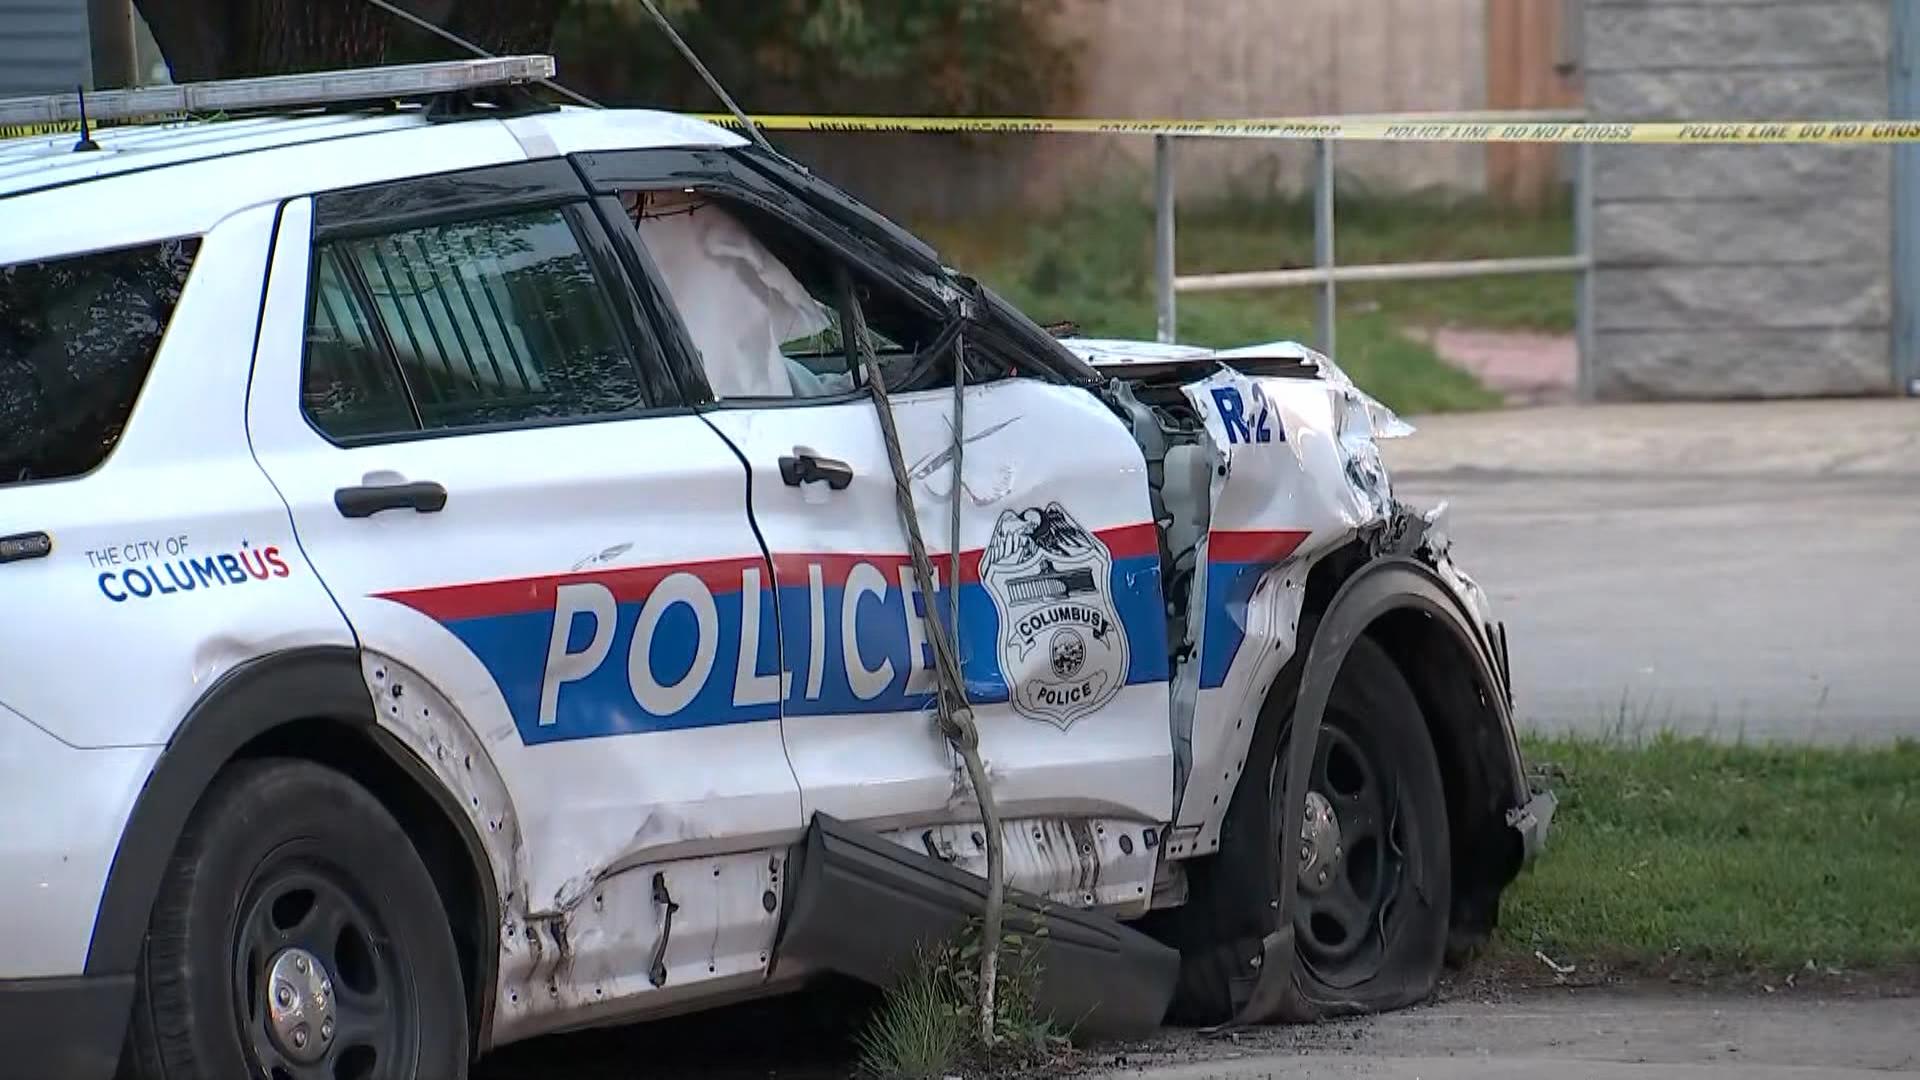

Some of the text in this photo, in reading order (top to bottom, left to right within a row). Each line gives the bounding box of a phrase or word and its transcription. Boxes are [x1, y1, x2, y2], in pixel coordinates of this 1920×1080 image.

[1383, 125, 1633, 139] POLICE LINE DO NOT CROSS
[1678, 123, 1920, 139] POLICE LINE DO NOT CROS
[85, 535, 189, 569] THE CITY OF
[98, 546, 290, 602] COLUMBUS
[1020, 606, 1101, 637] COLUMBUS
[539, 562, 941, 727] POLICE
[1037, 682, 1092, 706] POLICE
